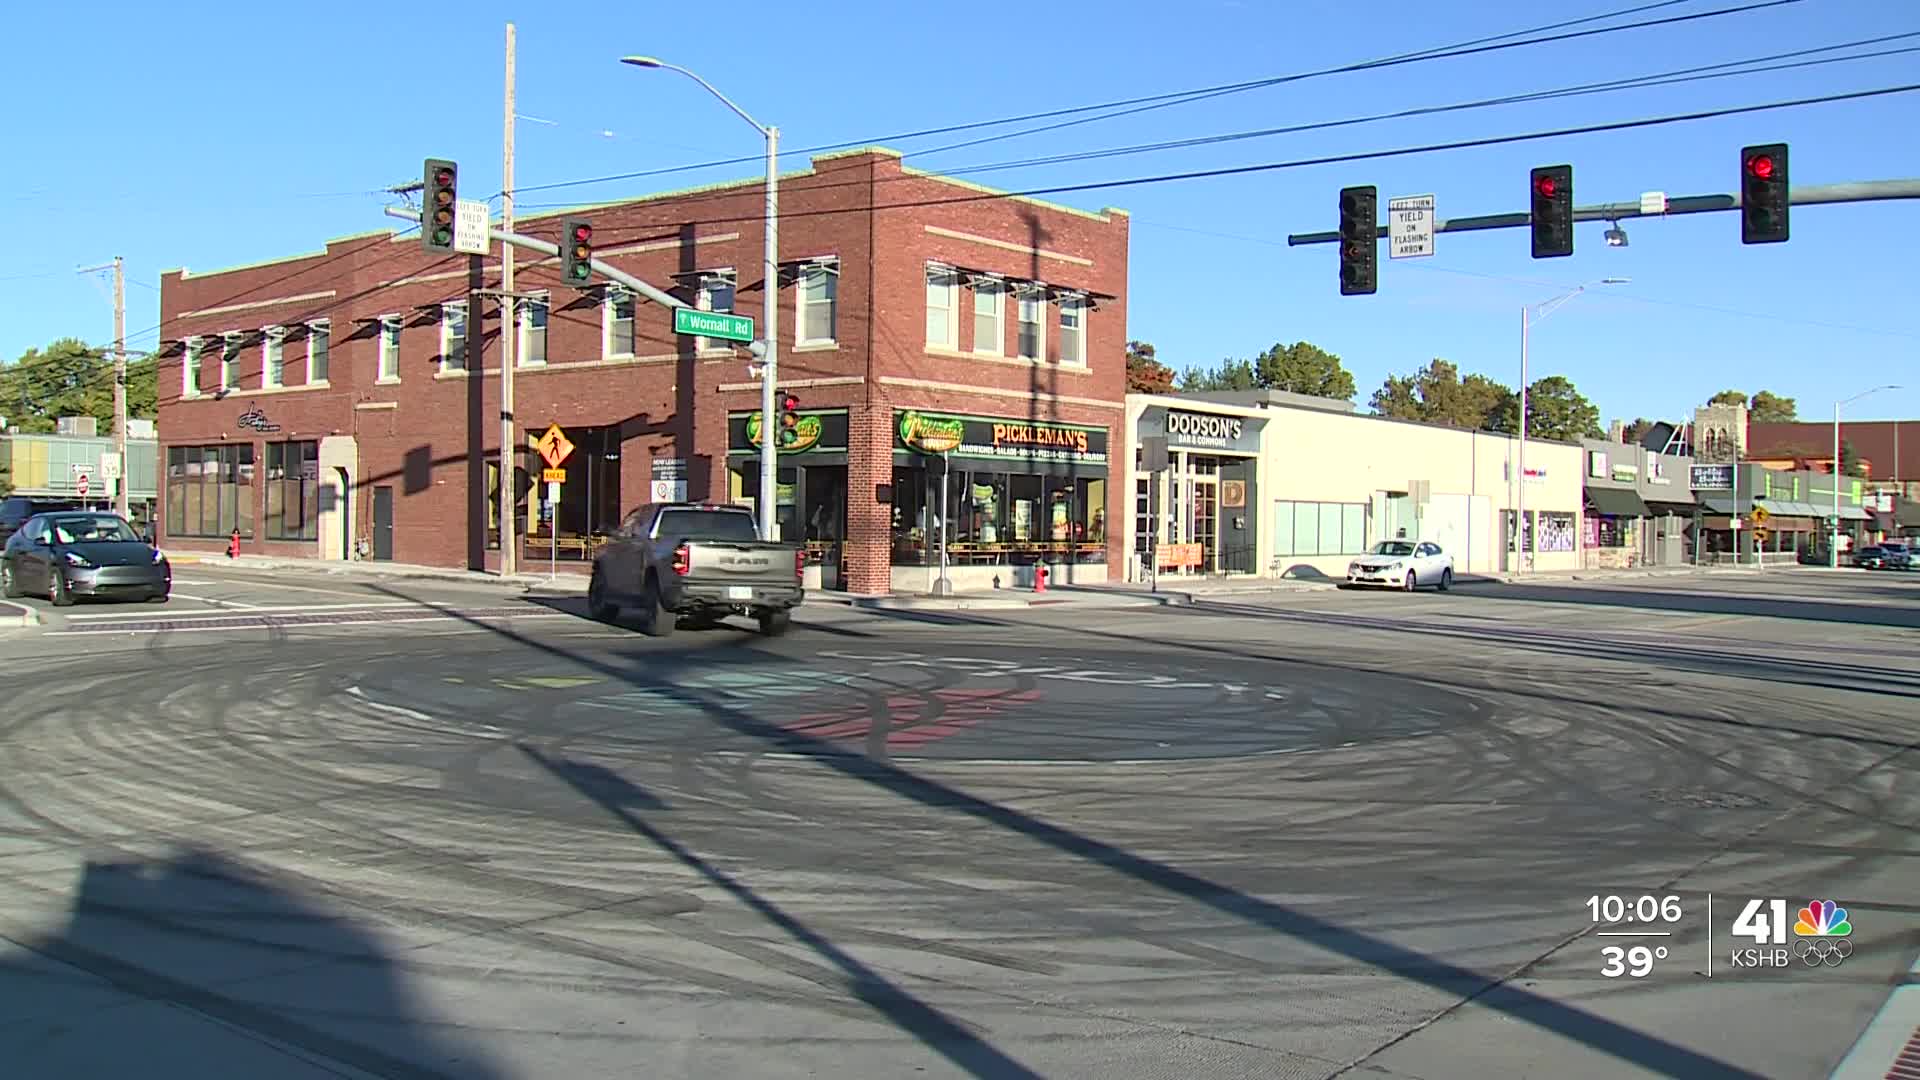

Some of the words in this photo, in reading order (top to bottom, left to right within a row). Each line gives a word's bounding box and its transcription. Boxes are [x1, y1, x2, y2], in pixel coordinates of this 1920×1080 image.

[1412, 200, 1430, 208] TURN
[1400, 211, 1424, 222] YIELD
[1406, 224, 1416, 232] ON
[1394, 233, 1428, 244] FLASHING
[1400, 244, 1424, 254] ARROW
[690, 315, 730, 332] Wornall
[735, 321, 748, 335] Rd
[1168, 413, 1242, 440] DODSON'S
[993, 424, 1089, 453] PICKLEMAN'S
[1178, 434, 1191, 444] BAR
[719, 556, 769, 565] RAM
